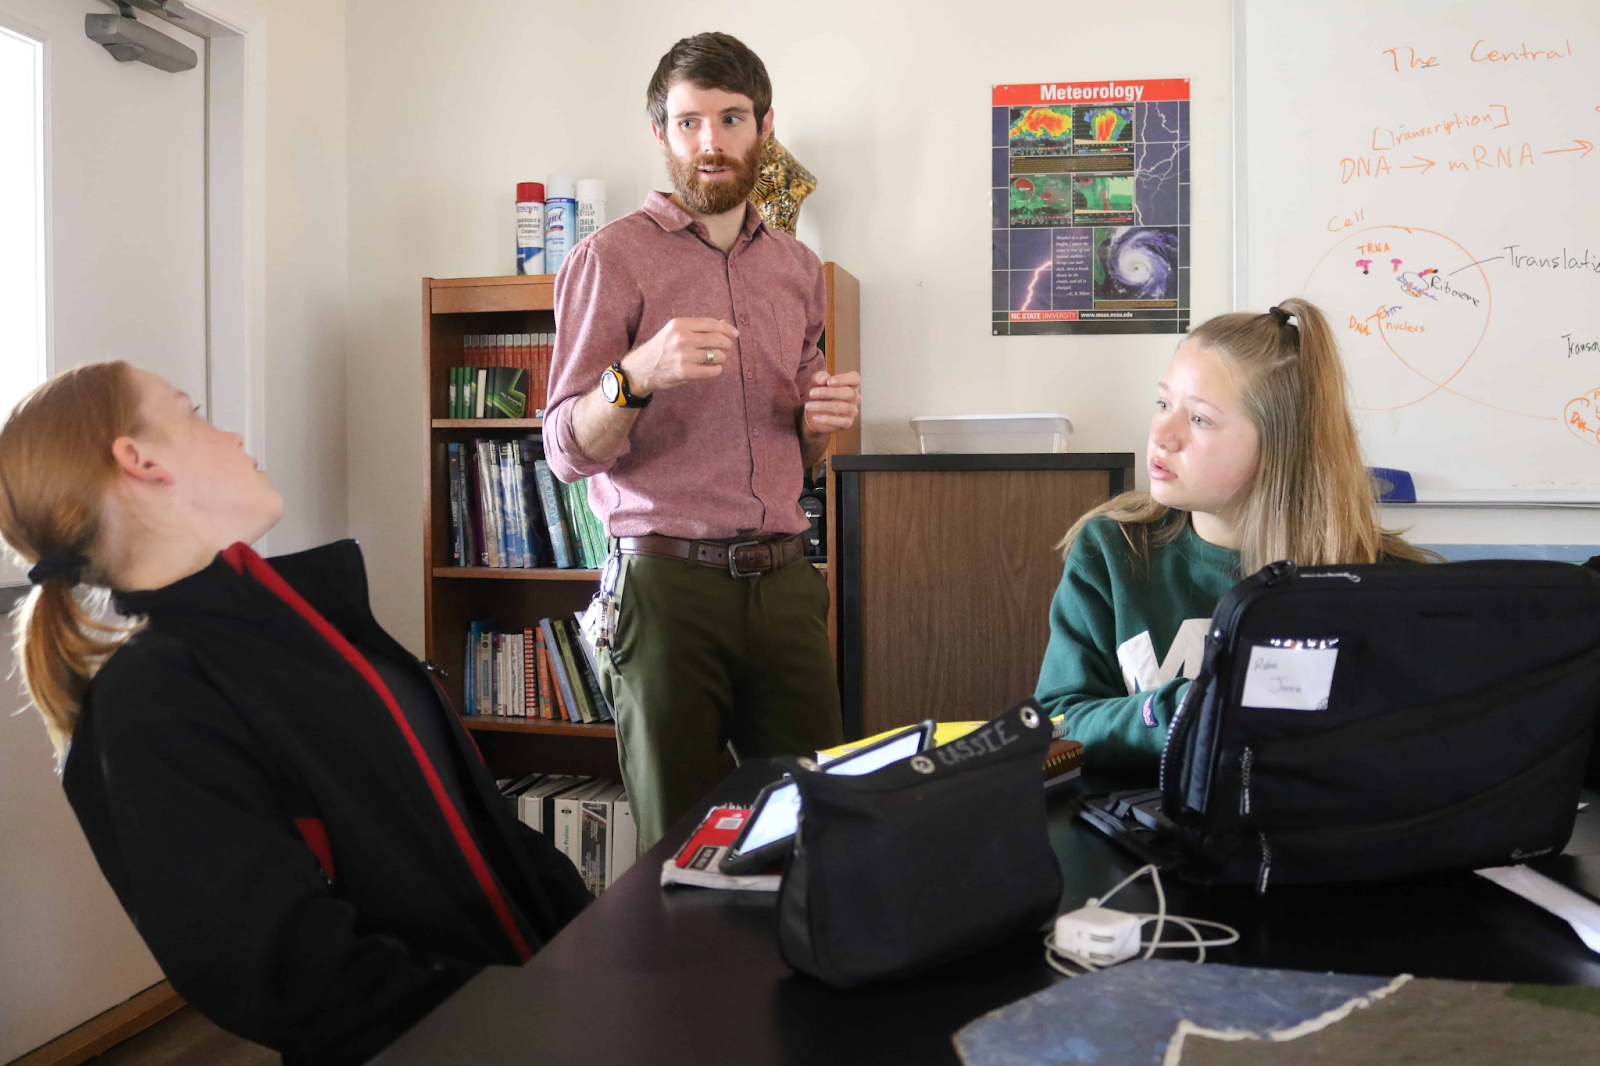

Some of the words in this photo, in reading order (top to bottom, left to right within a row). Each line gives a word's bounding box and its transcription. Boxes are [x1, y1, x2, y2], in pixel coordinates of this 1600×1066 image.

[1382, 46, 1441, 72] The
[1470, 39, 1572, 63] Central
[1040, 81, 1145, 102] Meteorology
[1339, 155, 1392, 184] DNA
[1448, 142, 1535, 171] mRNA
[1327, 208, 1365, 233] Cell
[542, 476, 559, 518] BIOLOGY
